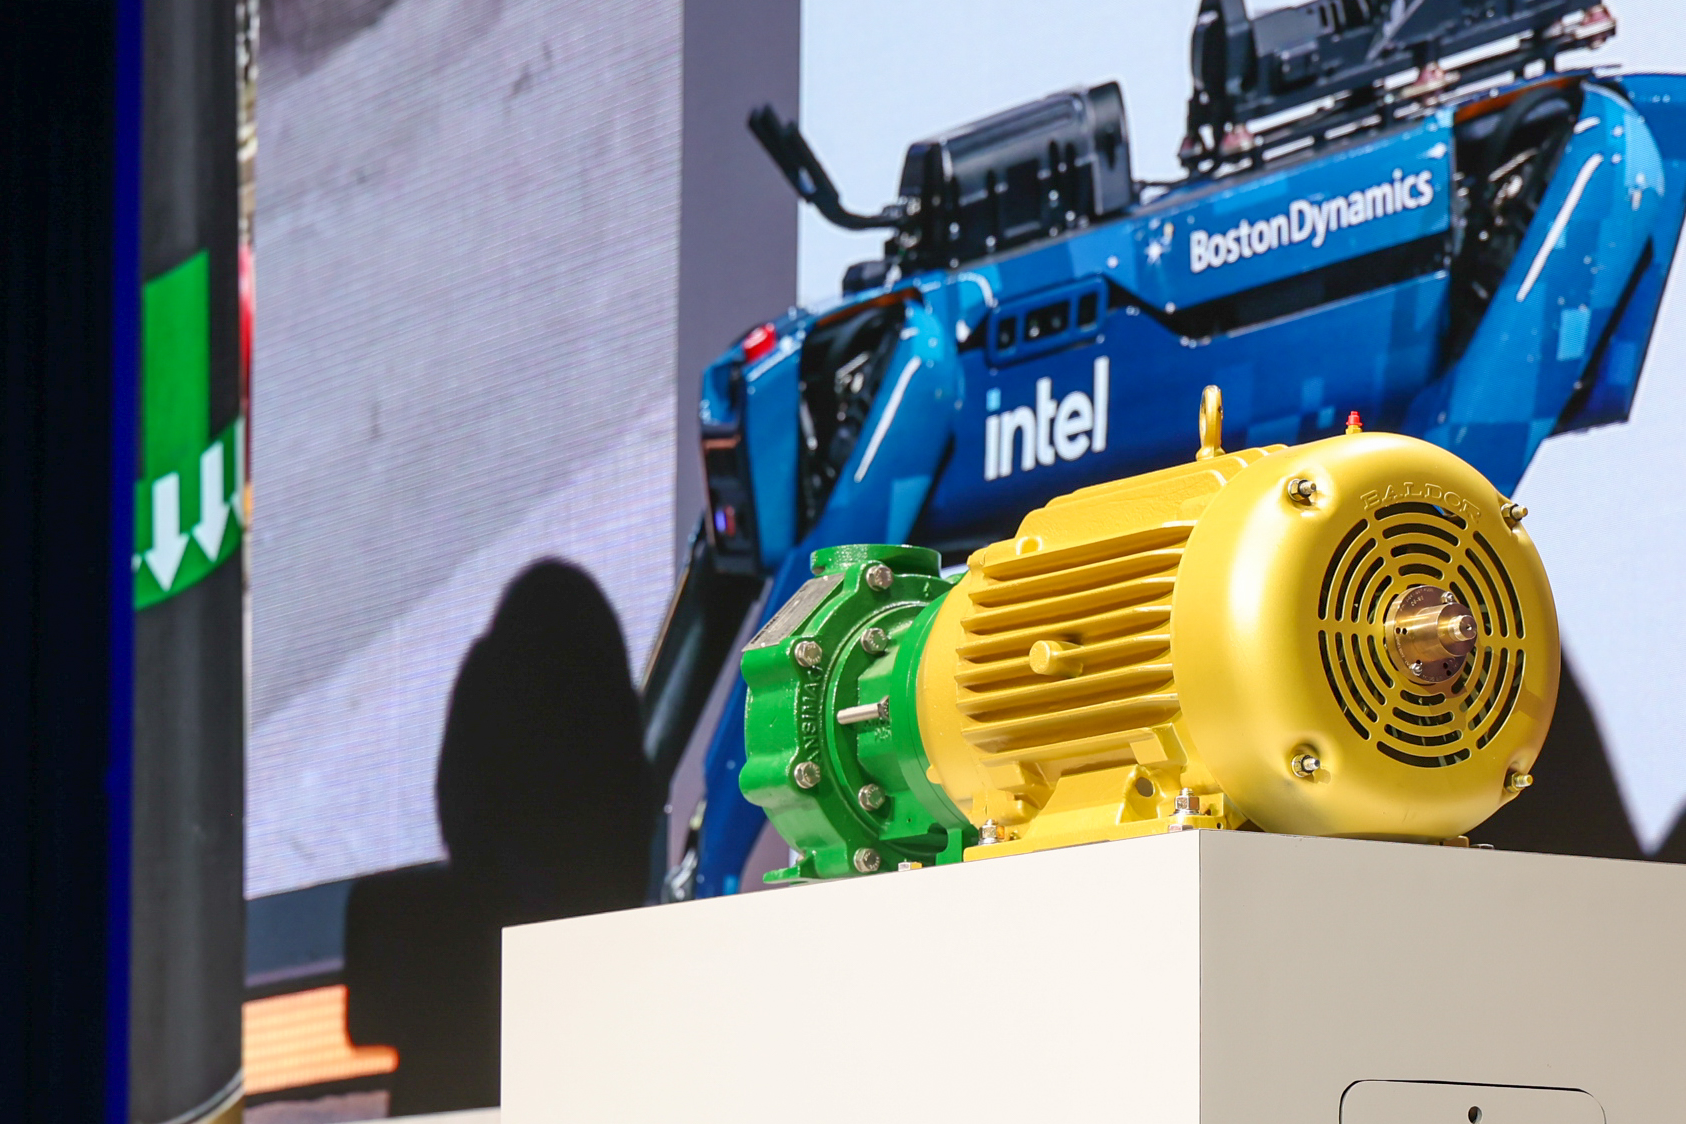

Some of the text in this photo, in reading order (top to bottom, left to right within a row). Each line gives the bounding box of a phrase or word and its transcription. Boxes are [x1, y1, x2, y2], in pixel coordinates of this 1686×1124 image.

[1190, 168, 1434, 274] BostonDynamics
[984, 355, 1110, 481] intel
[1360, 481, 1482, 524] BALDOR
